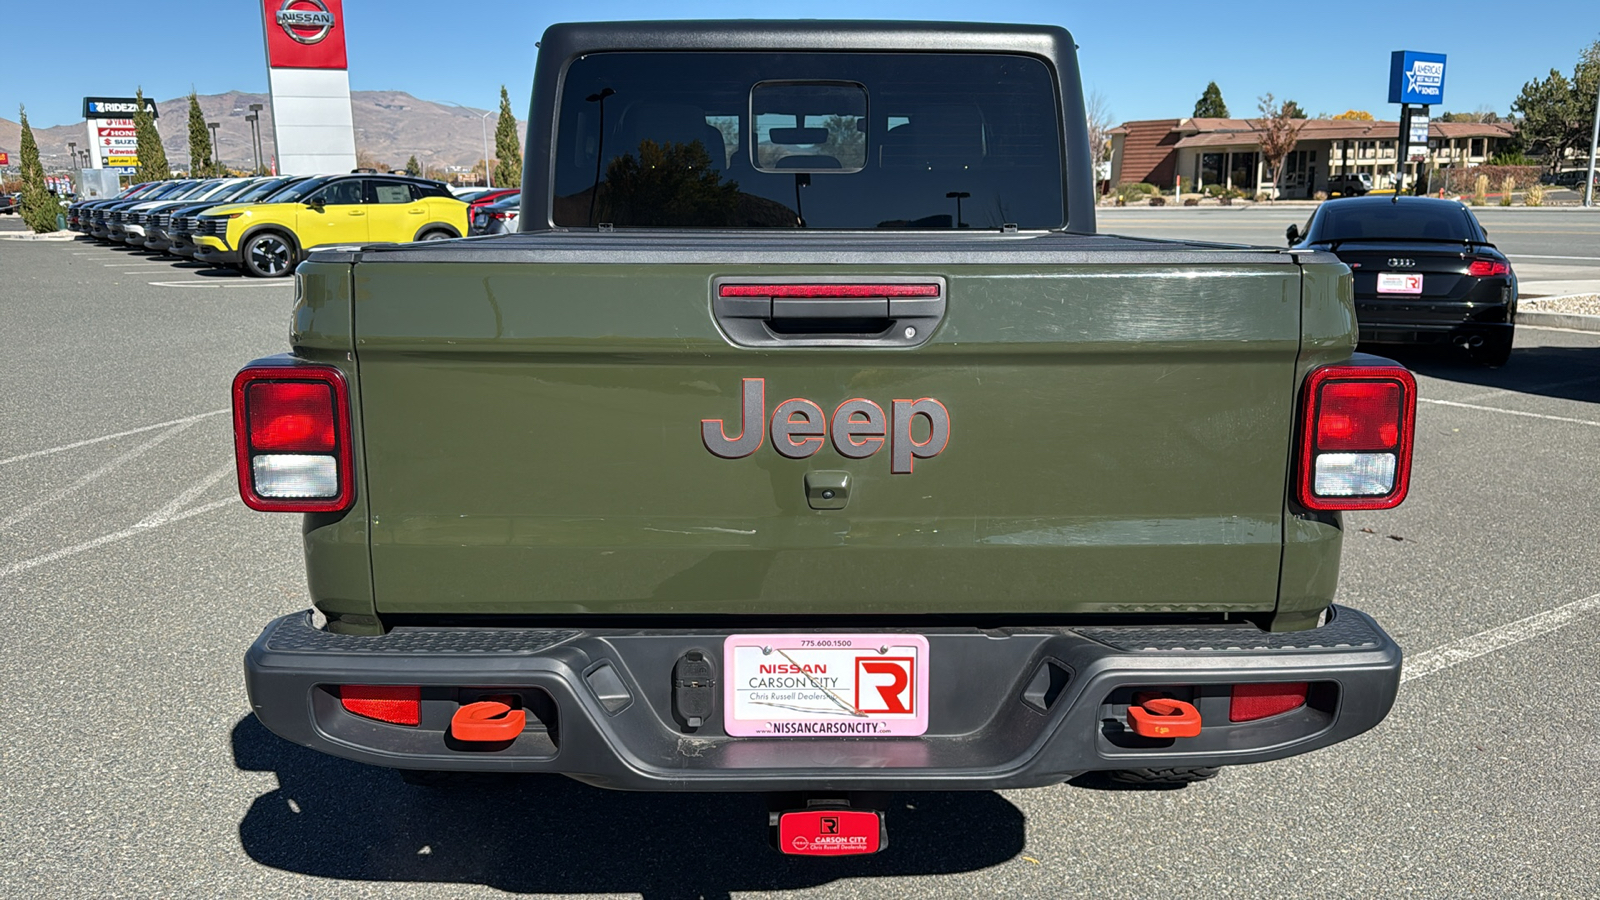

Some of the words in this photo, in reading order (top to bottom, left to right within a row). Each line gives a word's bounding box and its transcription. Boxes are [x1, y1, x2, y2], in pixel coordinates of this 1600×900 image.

[282, 13, 329, 22] NISSAN
[700, 378, 950, 474] Jeep
[759, 664, 827, 674] NISSAN
[749, 677, 806, 688] CARSON
[810, 677, 838, 688] CITY
[749, 692, 769, 700] Chris
[771, 692, 796, 700] Russell
